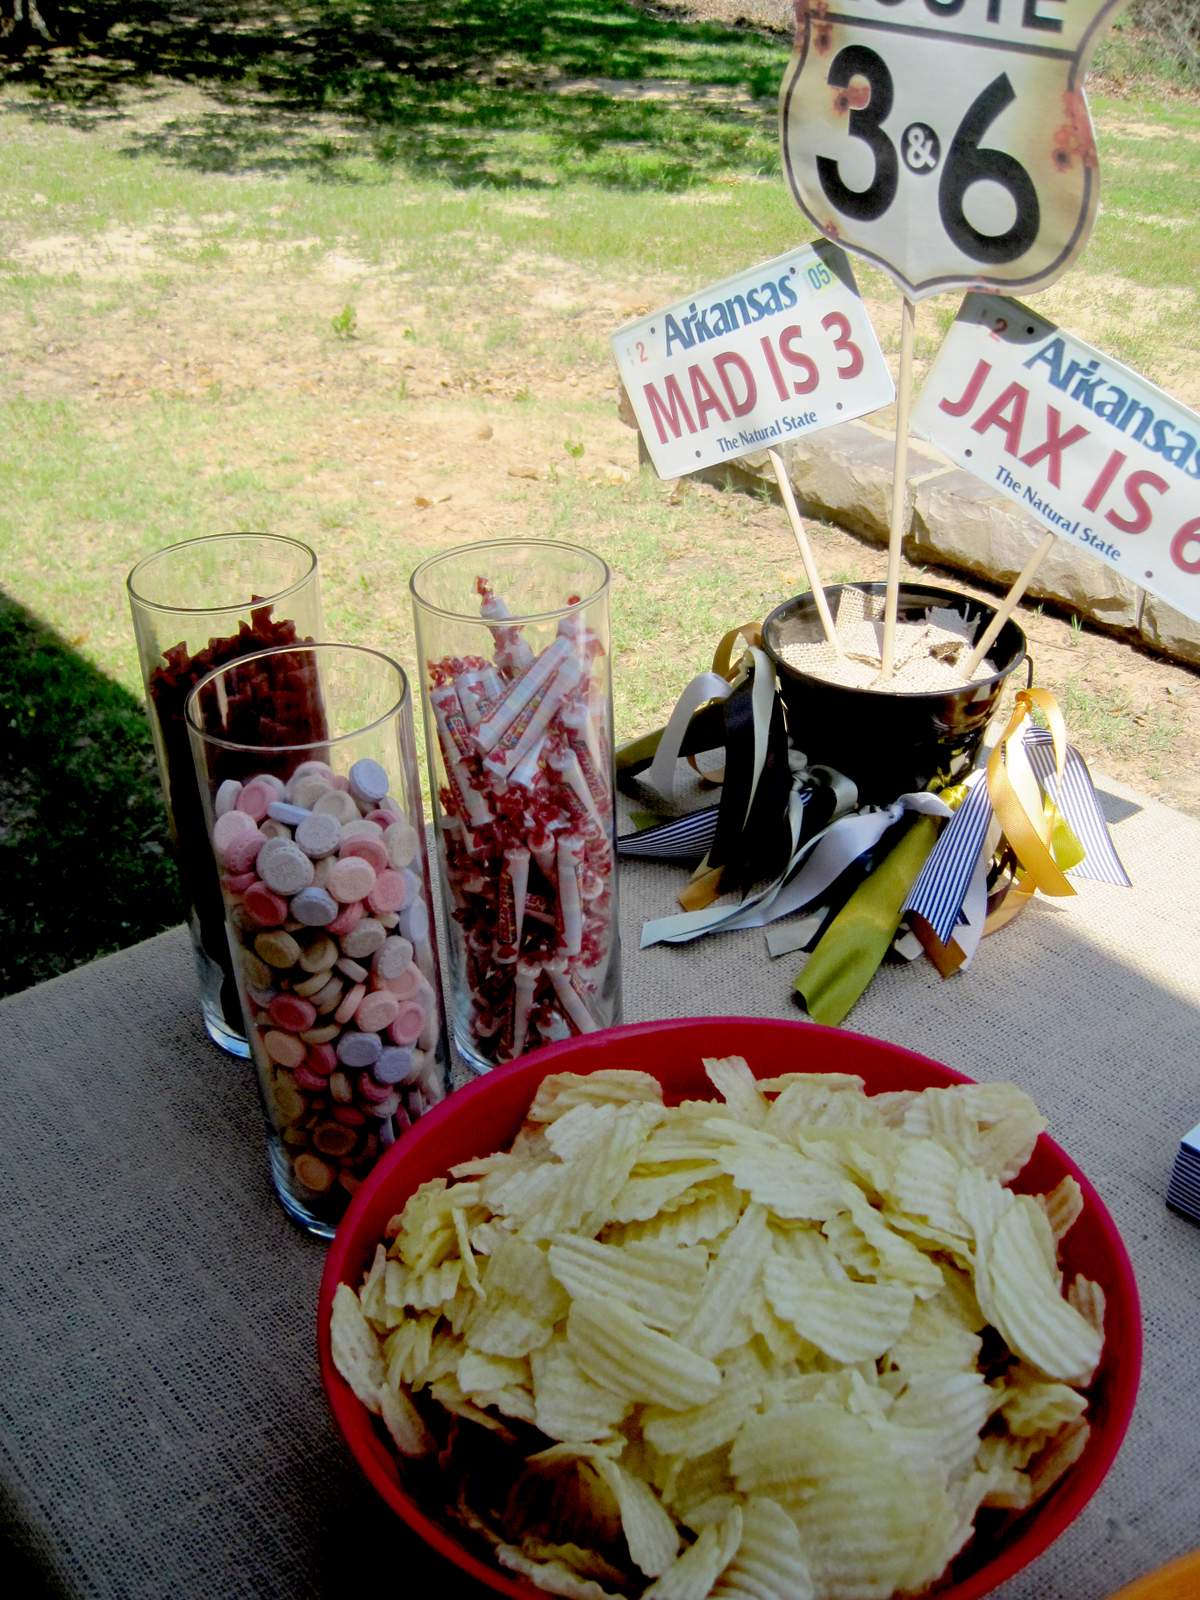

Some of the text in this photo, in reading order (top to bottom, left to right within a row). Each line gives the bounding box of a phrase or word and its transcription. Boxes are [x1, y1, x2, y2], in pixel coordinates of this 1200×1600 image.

[816, 44, 899, 222] 3
[938, 71, 1041, 264] 6
[664, 274, 799, 358] Arkansas
[808, 263, 832, 290] 05
[635, 340, 648, 362] 2
[642, 311, 865, 445] MAD IS 3
[716, 411, 817, 454] The Natural State
[938, 358, 1090, 491] JAX
[1081, 448, 1171, 535] IS
[995, 464, 1122, 562] The Natural State
